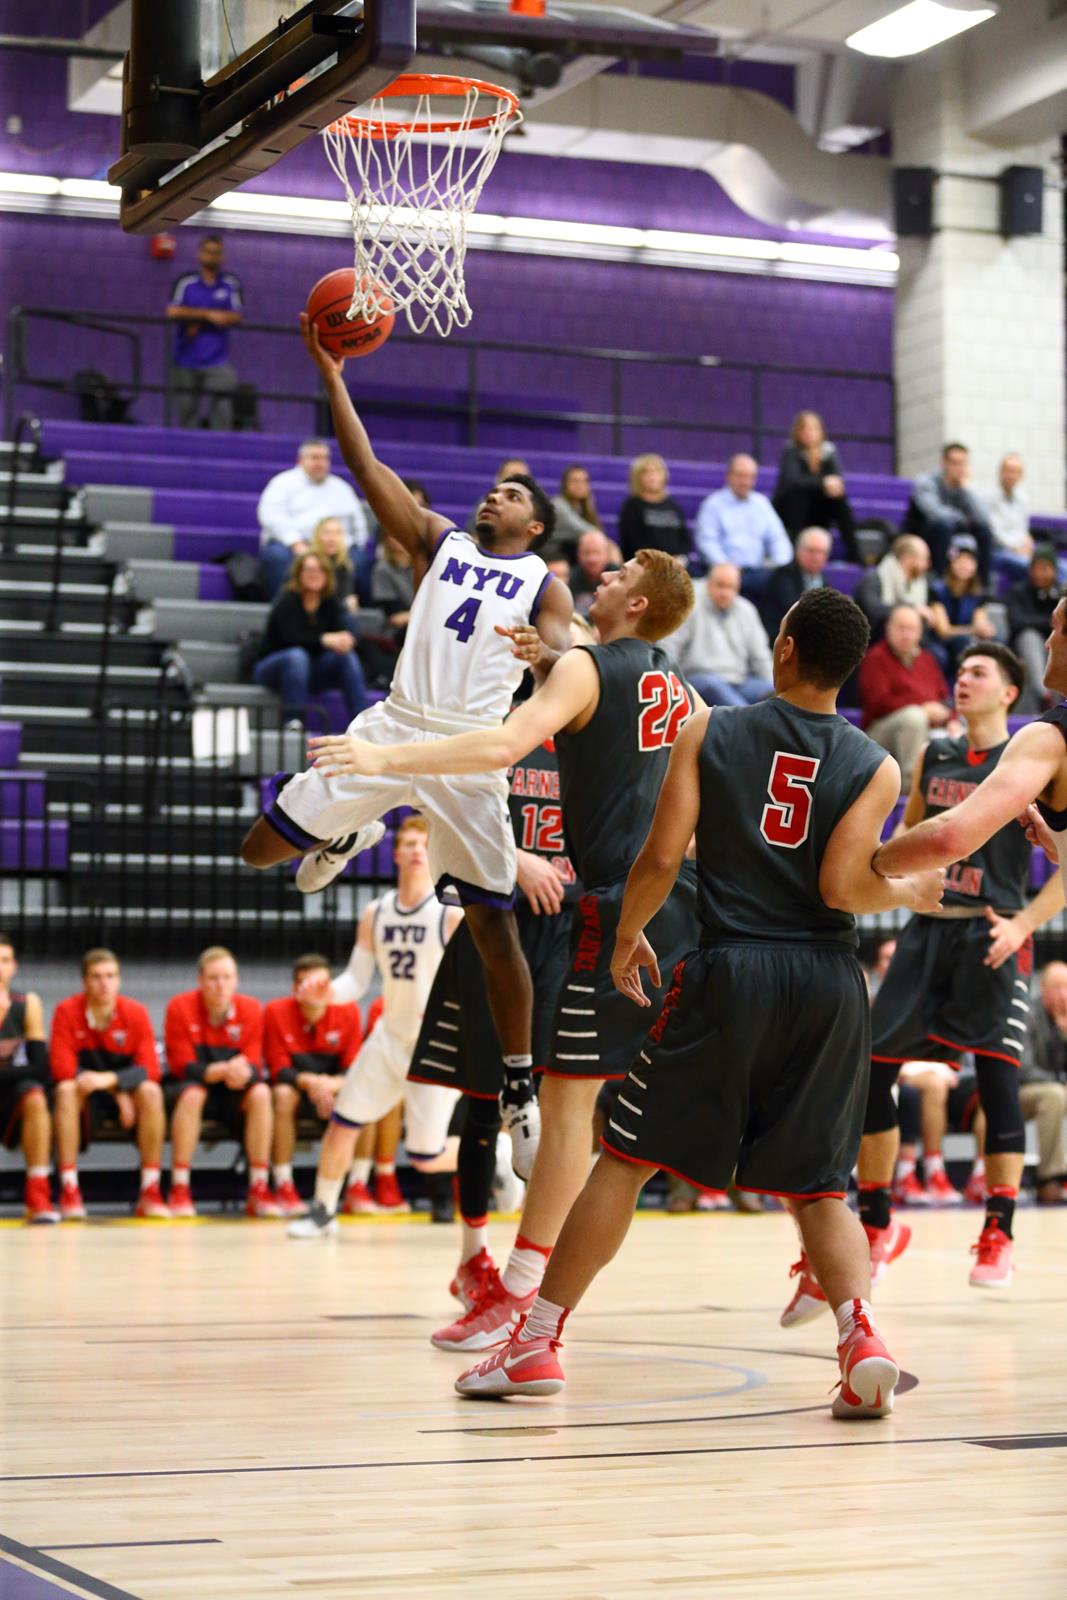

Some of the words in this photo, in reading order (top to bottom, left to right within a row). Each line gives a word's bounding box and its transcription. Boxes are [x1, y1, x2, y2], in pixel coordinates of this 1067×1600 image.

[439, 556, 525, 600] NYU
[444, 596, 482, 643] 4
[638, 670, 693, 752] 22
[759, 750, 820, 850] 5
[521, 803, 565, 852] 12
[383, 924, 427, 944] NYU
[389, 949, 417, 980] 22
